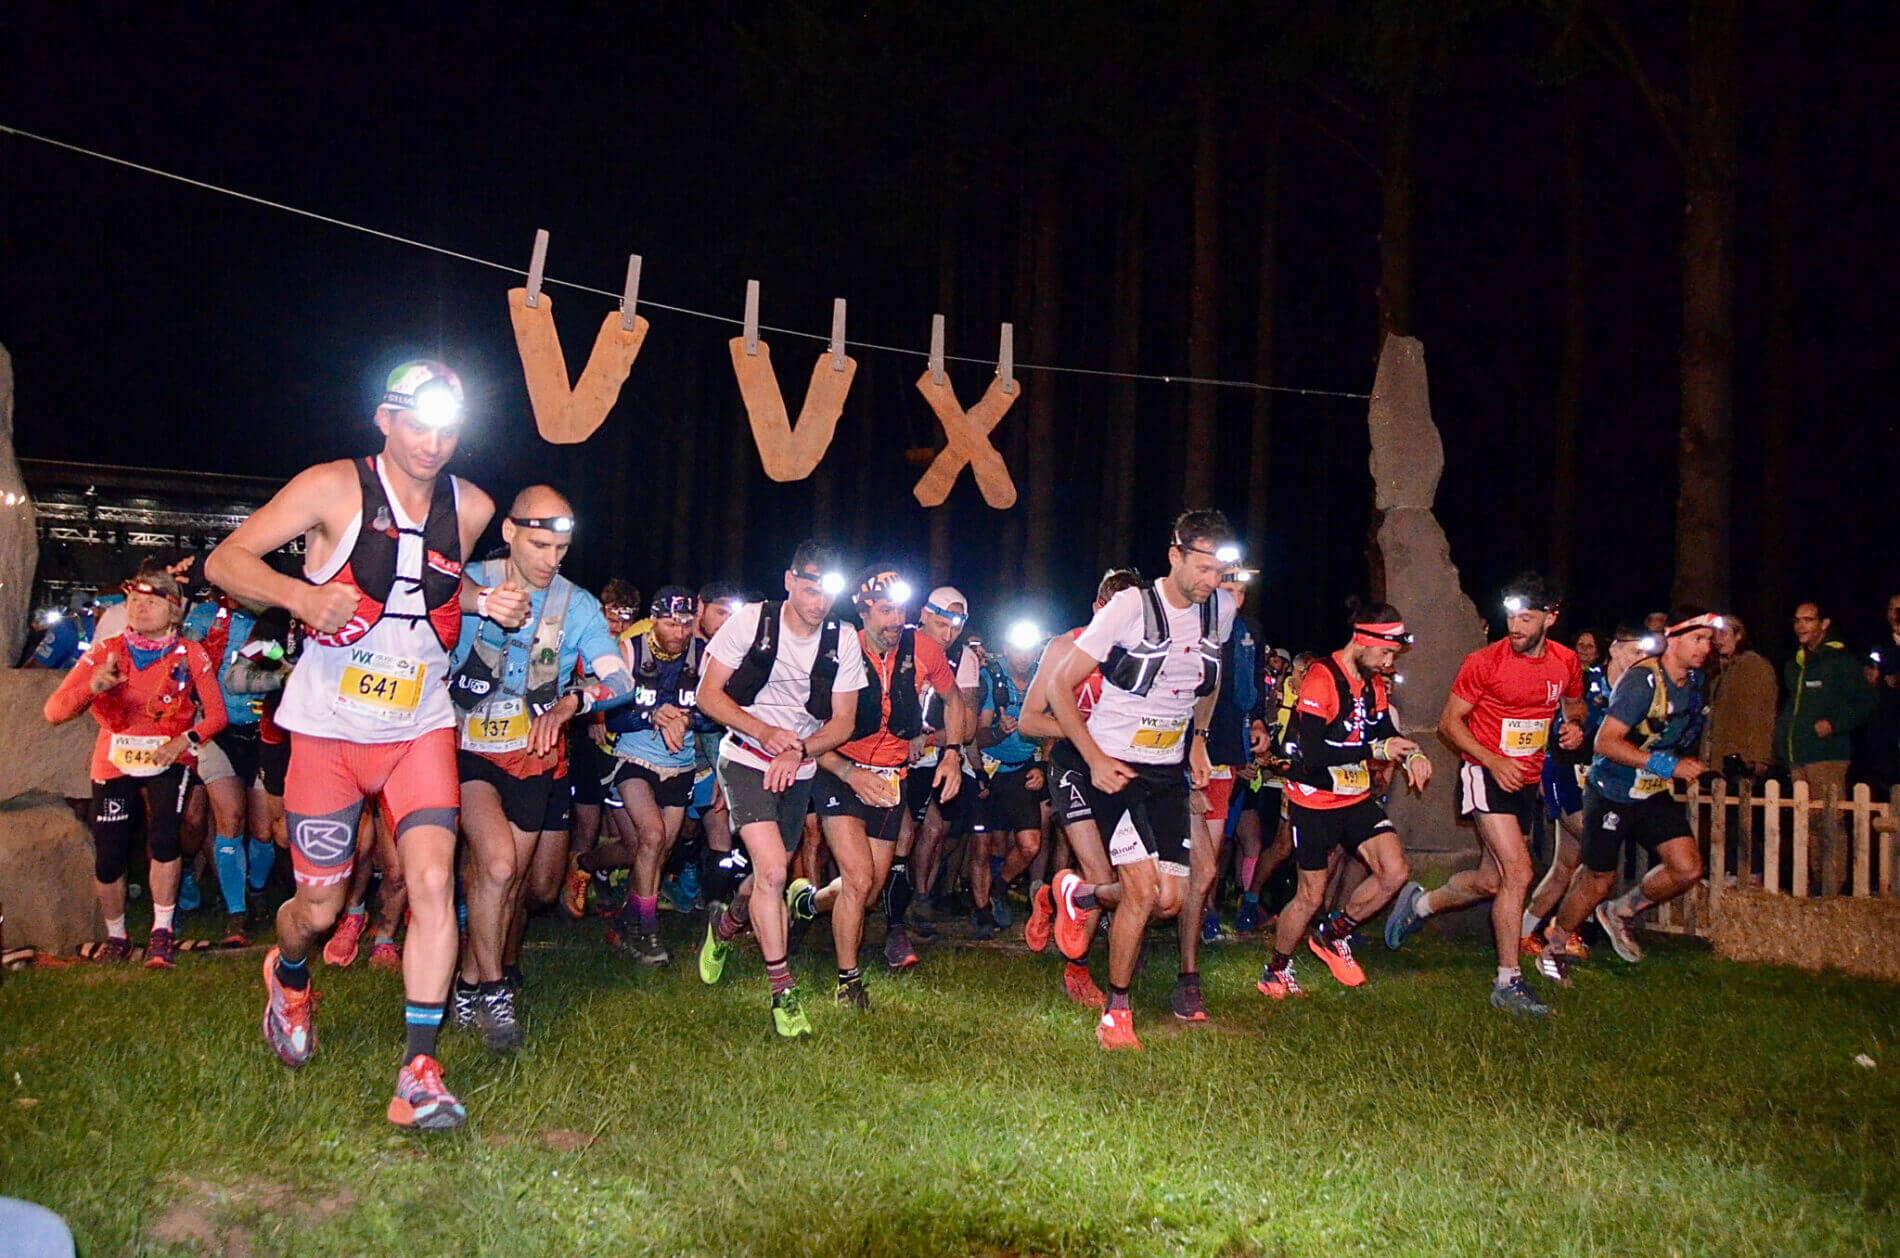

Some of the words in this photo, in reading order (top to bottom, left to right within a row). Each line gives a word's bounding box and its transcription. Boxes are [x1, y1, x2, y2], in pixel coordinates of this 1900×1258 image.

[351, 648, 374, 665] VVX
[358, 673, 398, 700] 641
[480, 719, 510, 737] 137
[1141, 716, 1158, 728] VVX
[1154, 731, 1163, 745] 1
[1517, 732, 1534, 745] 56
